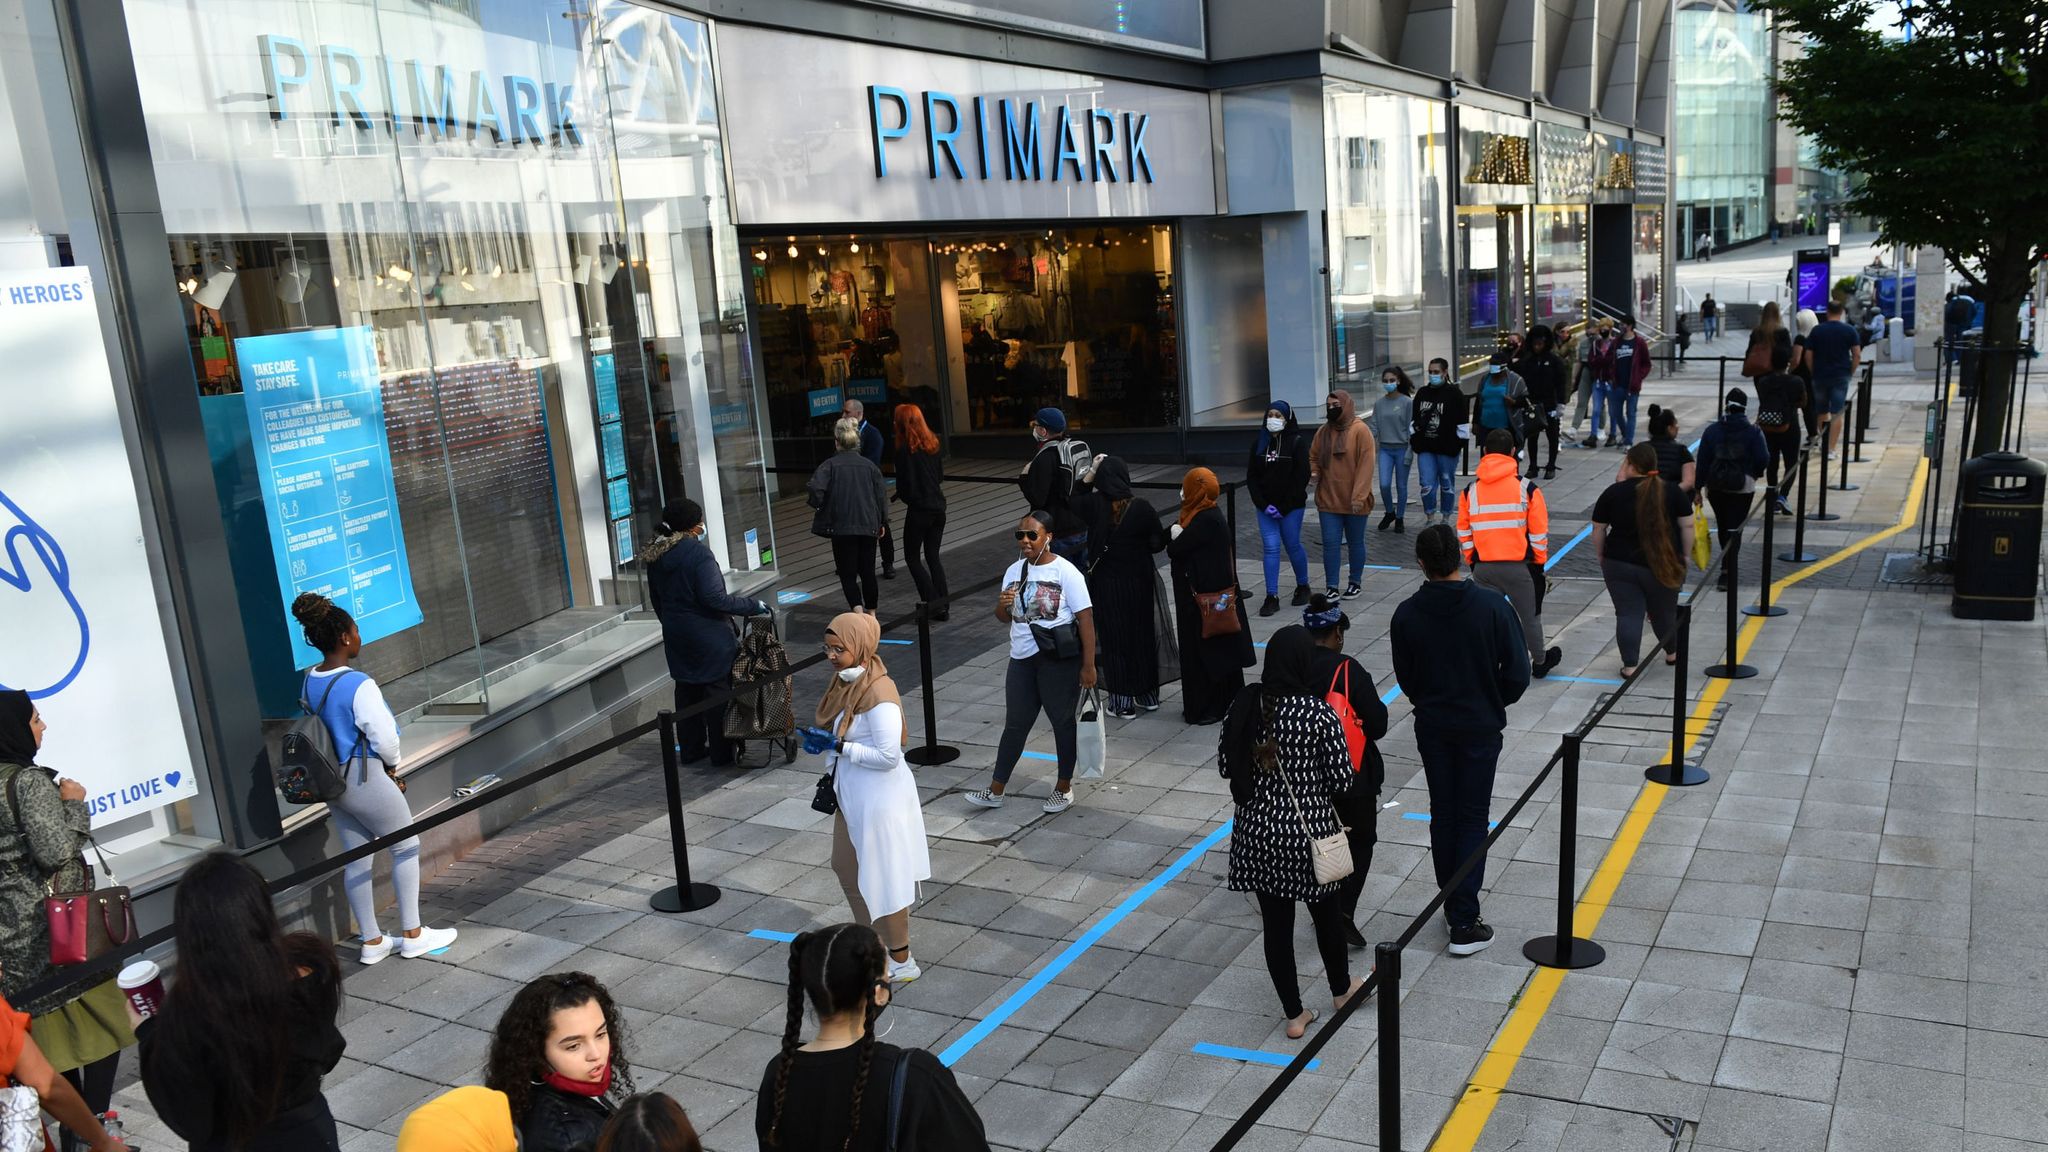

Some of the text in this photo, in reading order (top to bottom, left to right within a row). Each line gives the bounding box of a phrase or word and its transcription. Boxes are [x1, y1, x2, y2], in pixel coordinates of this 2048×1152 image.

[257, 34, 584, 147] PRIMARK
[867, 84, 1158, 184] PRIMARK
[9, 283, 83, 304] HEROES
[252, 359, 300, 376] TAKE CARE.
[255, 375, 300, 391] STAY SAFE.
[856, 386, 879, 395] ENTRY
[820, 394, 837, 406] ENTRY
[264, 409, 279, 421] FOR
[279, 407, 291, 418] THE
[324, 401, 332, 410] OF
[333, 400, 344, 409] OUR
[720, 411, 741, 424] ENTRY
[266, 417, 305, 432] COLLEAGUES
[305, 415, 317, 425] AND
[268, 418, 361, 443] WE HAVE MADE SOME IMPORTANT
[271, 435, 325, 453] CHANGES IN STORE
[277, 475, 296, 485] PLEASE
[341, 471, 356, 480] STORE
[278, 484, 297, 495] SOCIAL
[287, 533, 308, 544] LIMITED
[289, 540, 318, 551] CUSTOMERS
[323, 533, 337, 543] STORE
[319, 584, 332, 594] STORE
[358, 578, 372, 589] STORE
[89, 777, 162, 817] UST LOVE
[131, 992, 151, 1018] OSTA
